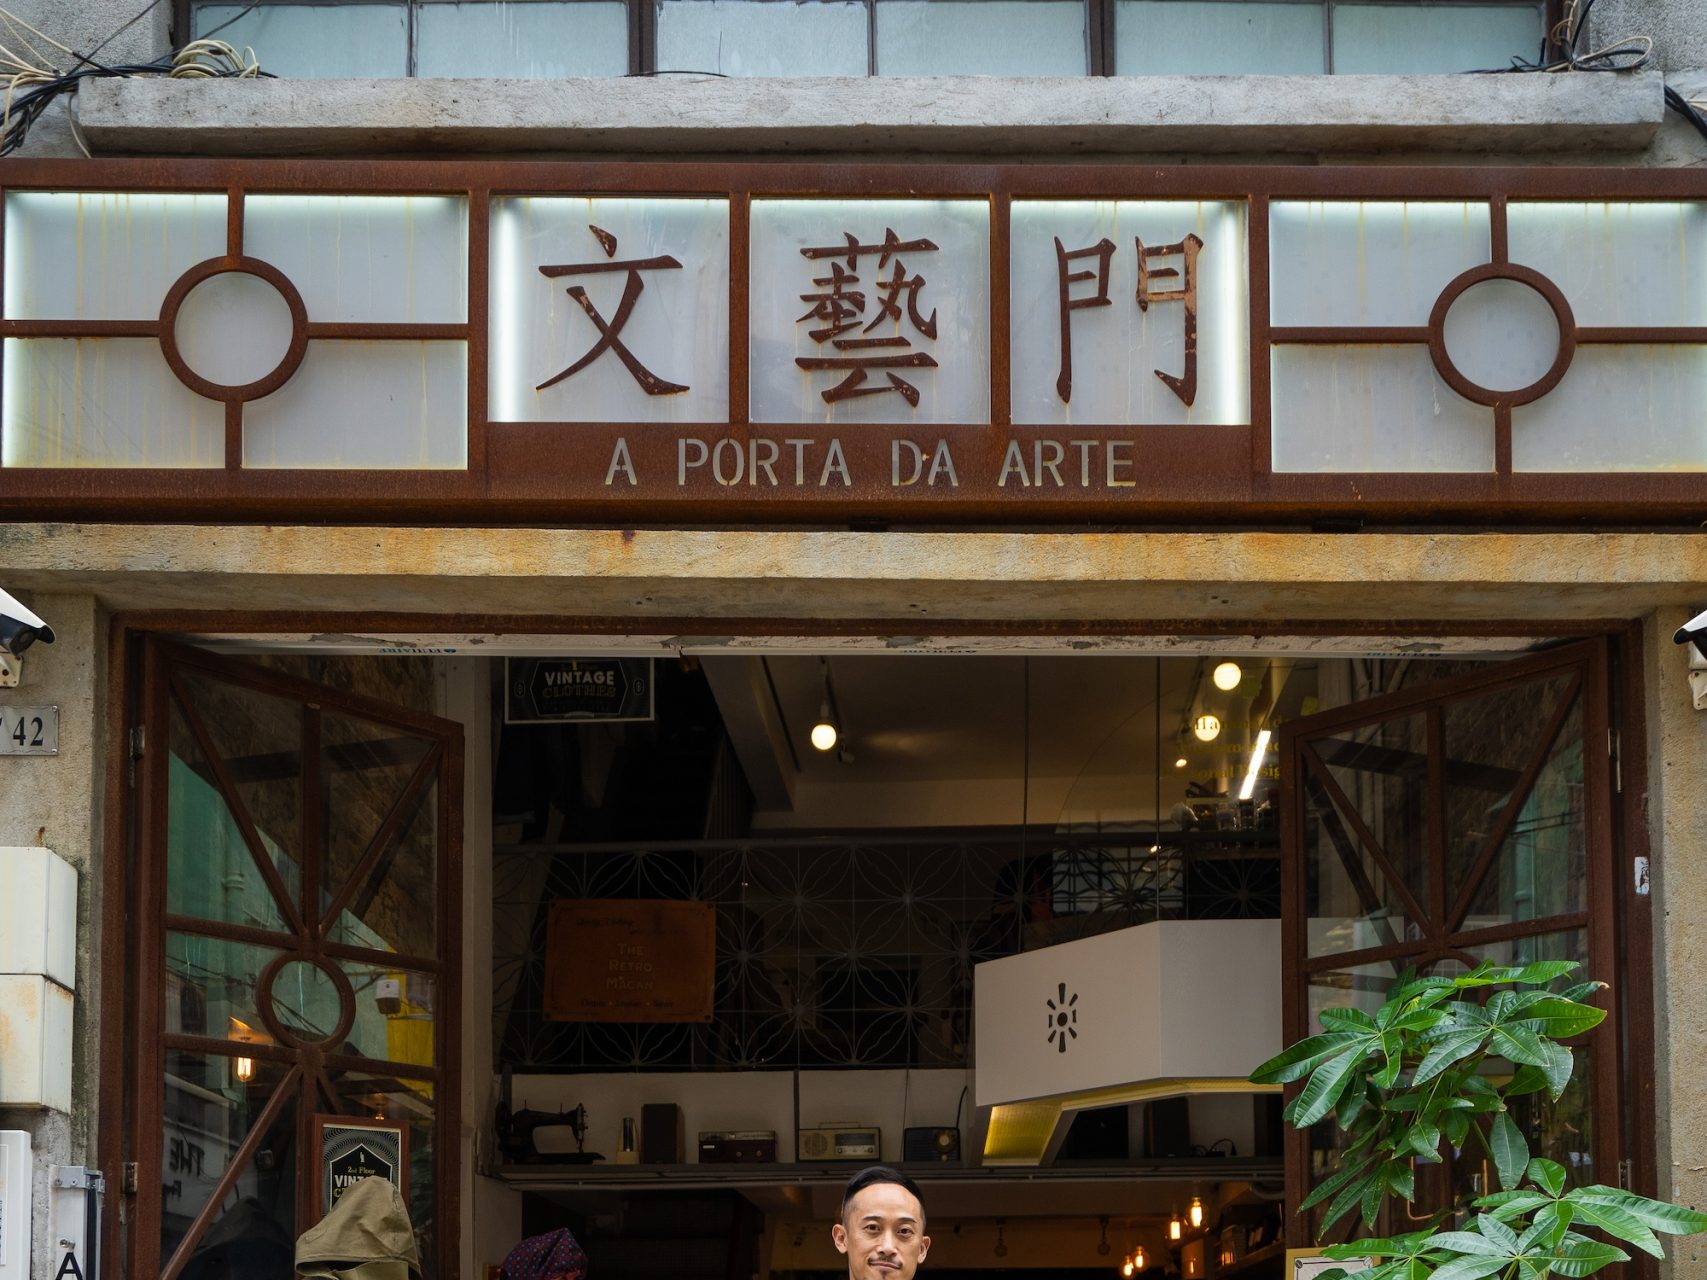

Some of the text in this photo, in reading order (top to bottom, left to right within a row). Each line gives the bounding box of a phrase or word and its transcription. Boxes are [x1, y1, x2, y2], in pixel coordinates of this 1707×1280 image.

[536, 224, 1203, 408] 文藝門
[604, 437, 1136, 489] A PORTA DA ARTE
[544, 669, 615, 686] VINTAGE
[12, 716, 44, 746] 42
[617, 943, 648, 956] THE
[608, 958, 653, 973] RETRO
[55, 1252, 83, 1280] A
